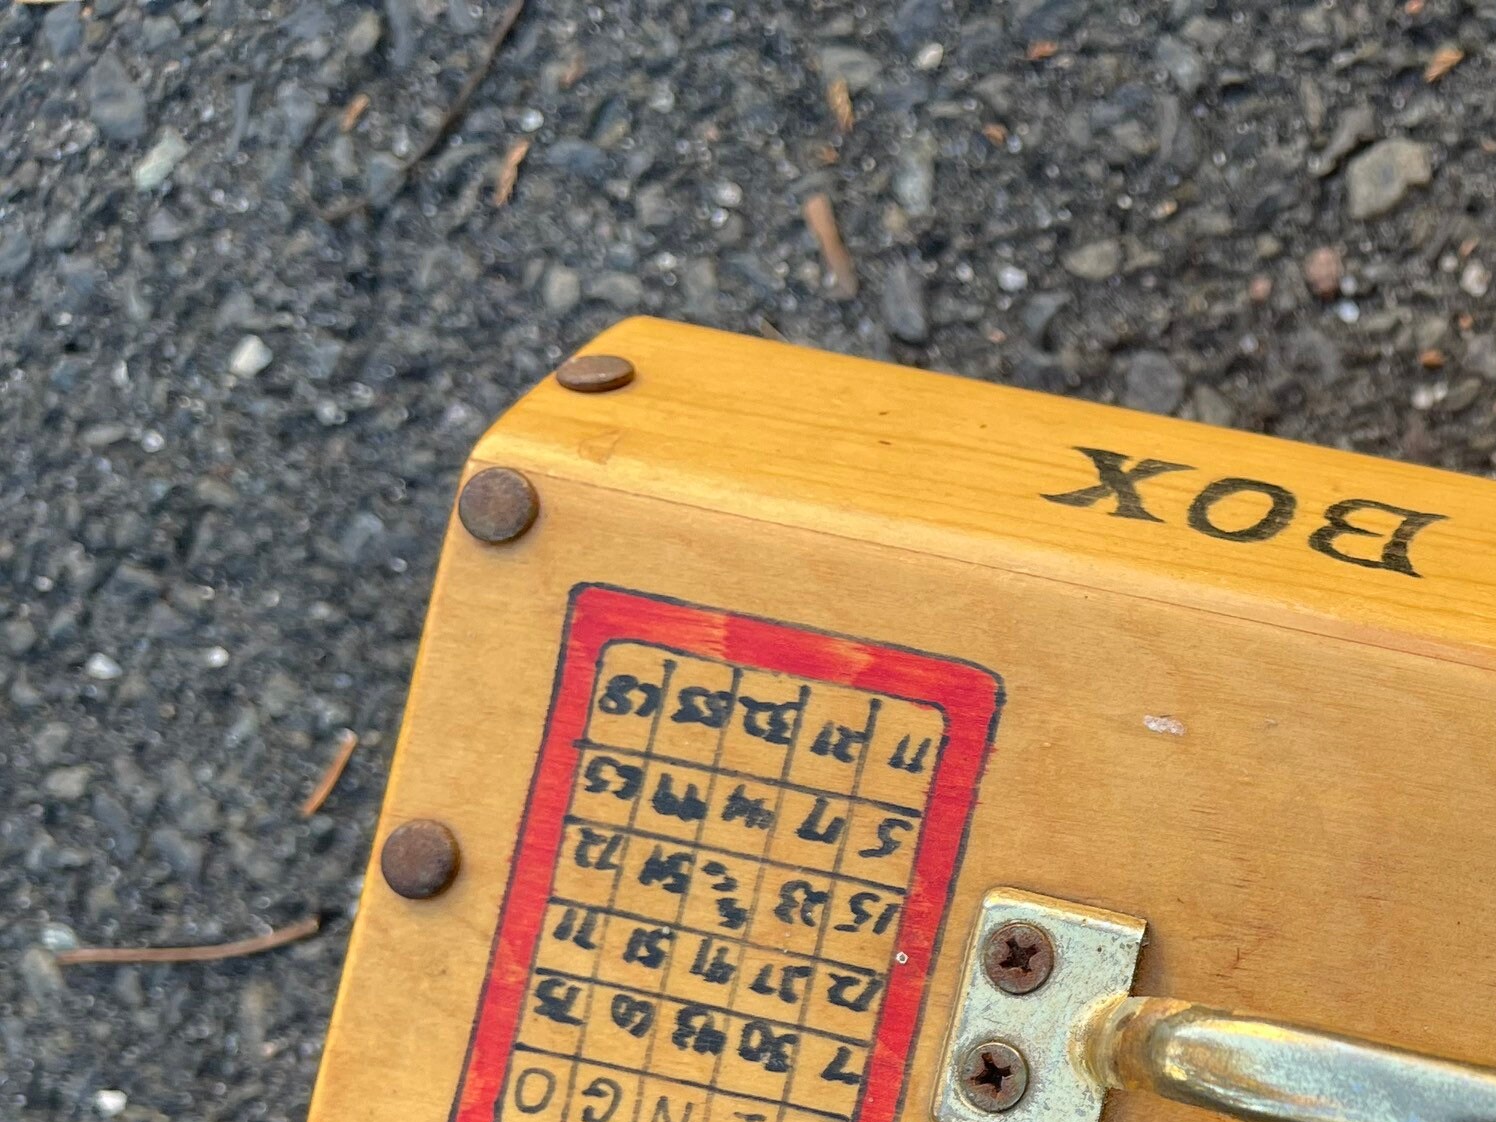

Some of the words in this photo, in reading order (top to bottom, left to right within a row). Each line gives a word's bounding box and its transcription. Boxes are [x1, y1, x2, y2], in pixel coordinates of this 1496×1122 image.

[1039, 445, 1449, 579] BOX
[858, 817, 913, 858] 5
[836, 891, 900, 934] 15
[822, 1045, 862, 1085] 7
